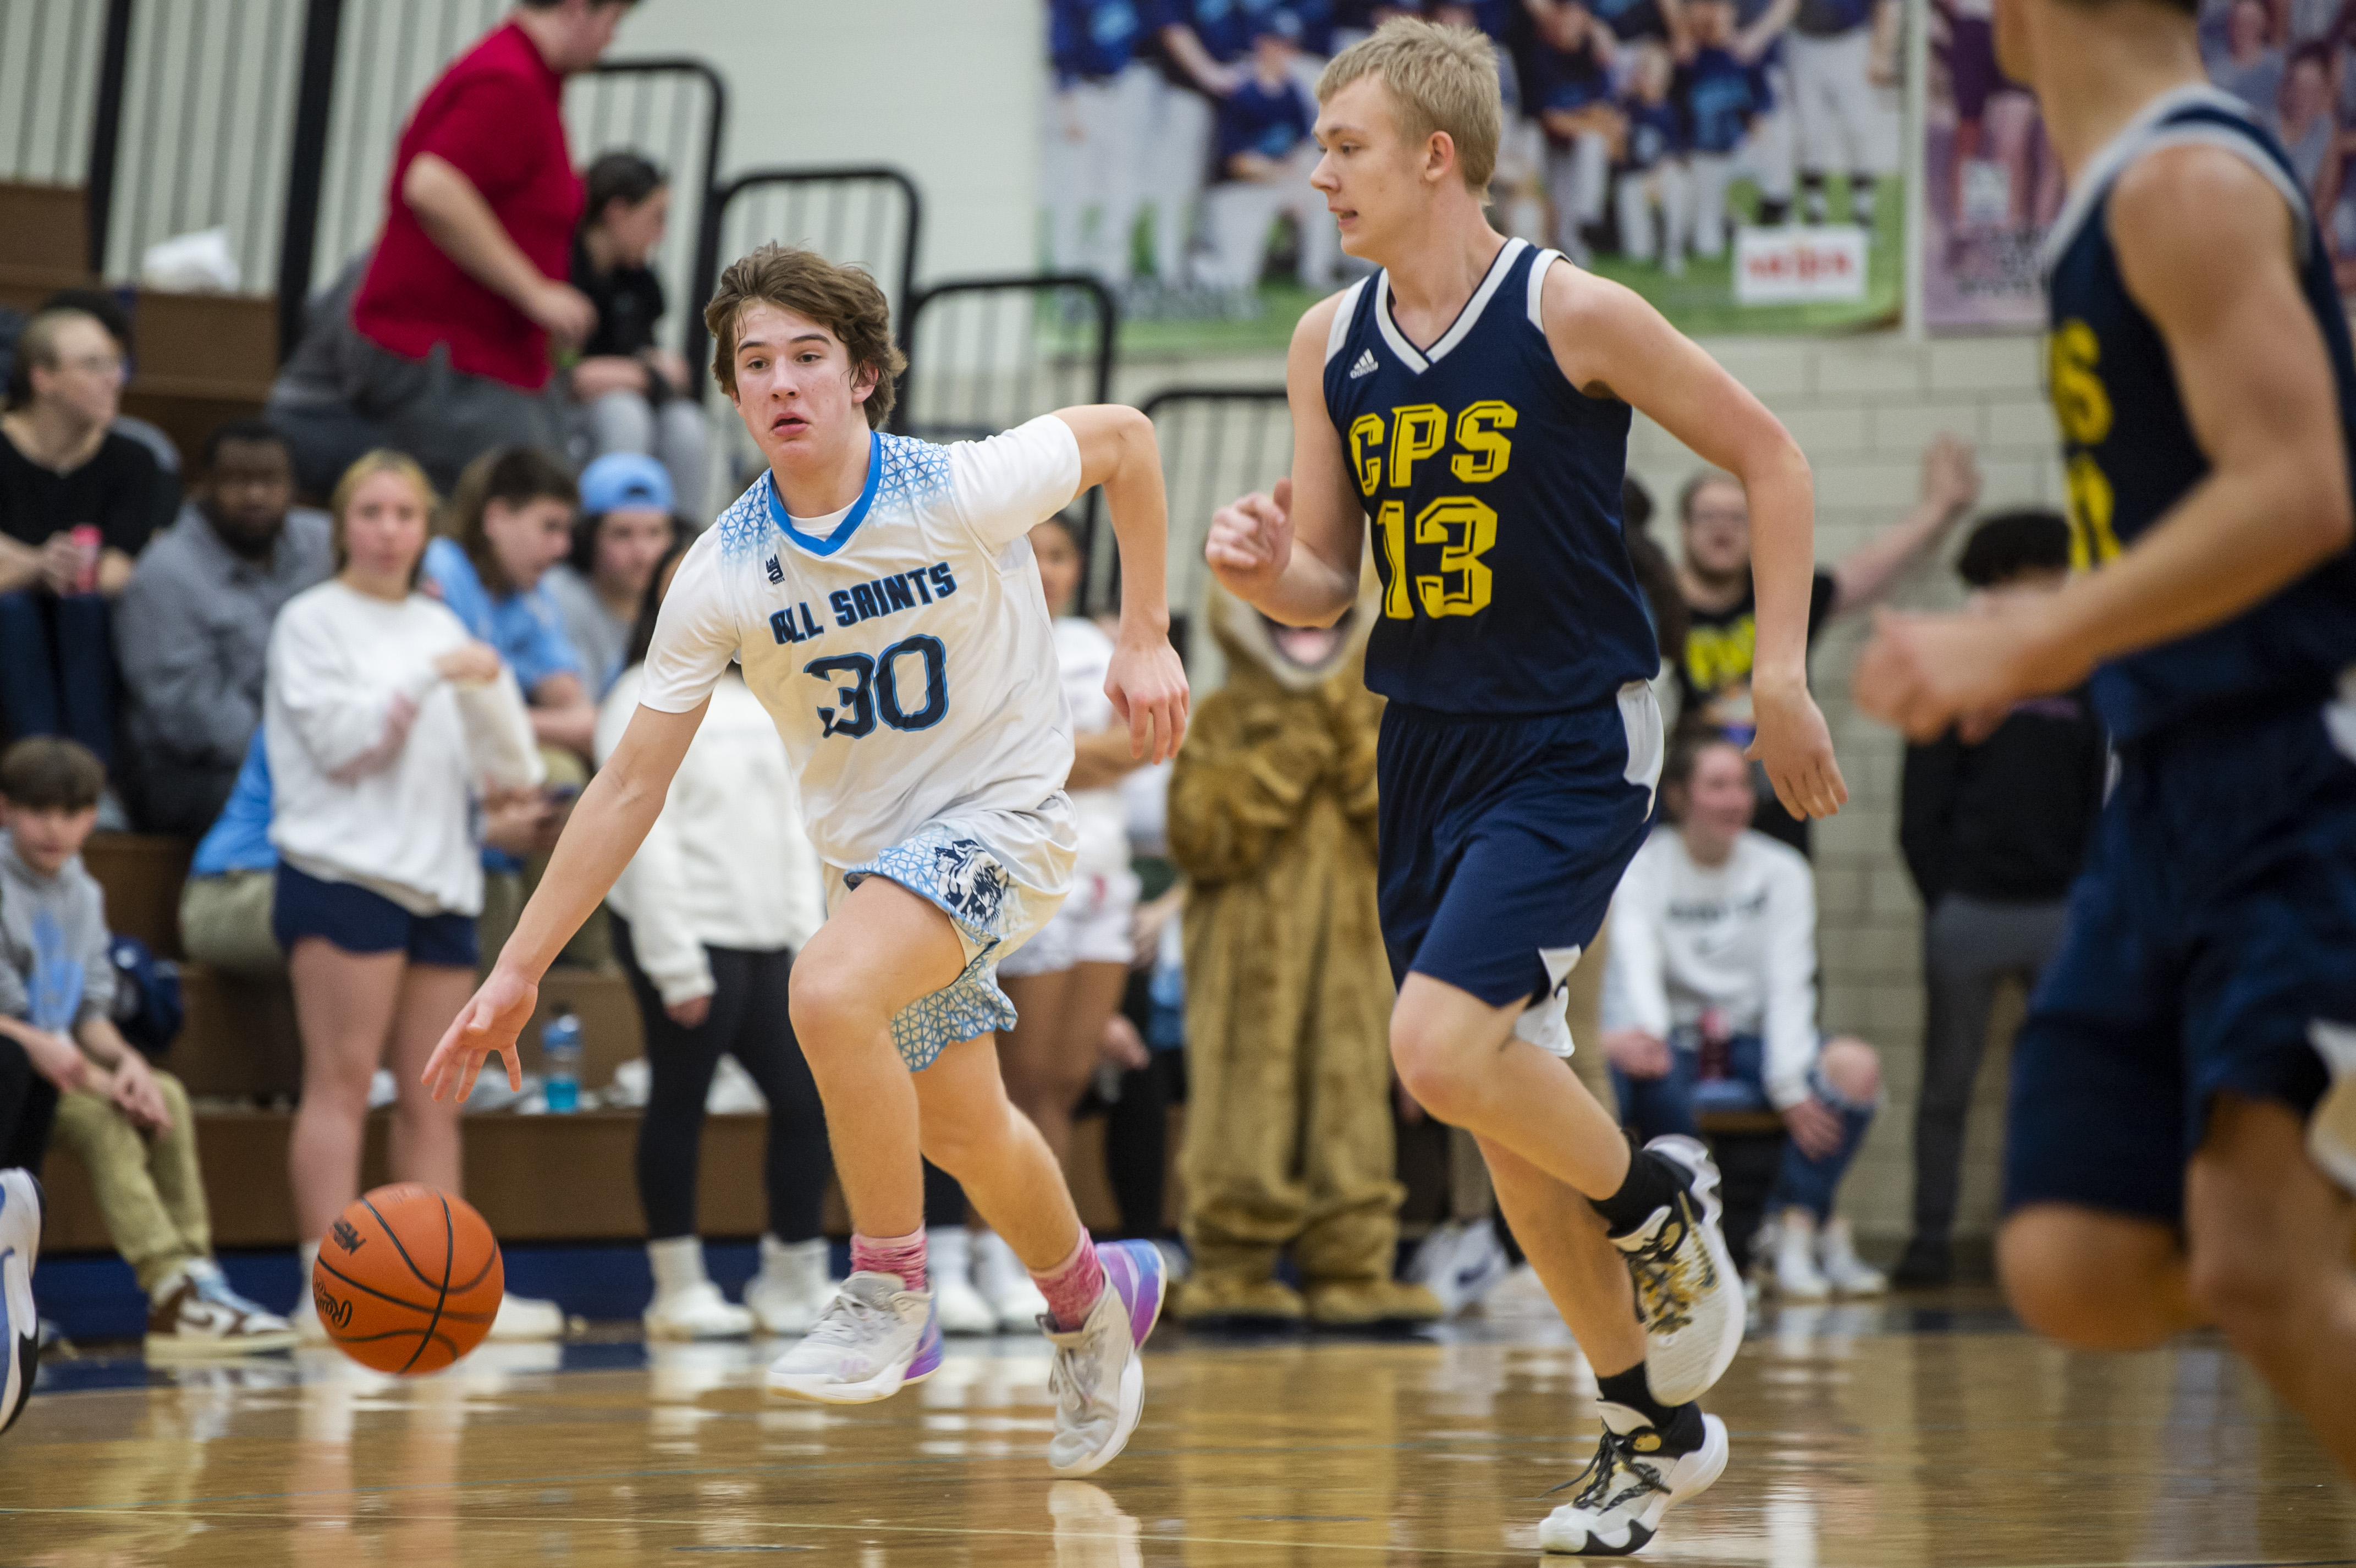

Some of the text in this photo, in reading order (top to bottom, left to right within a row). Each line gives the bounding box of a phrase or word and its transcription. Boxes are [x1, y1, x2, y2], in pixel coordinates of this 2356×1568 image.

[1349, 400, 1518, 497] CPS
[769, 562, 957, 645] ALL SAINTS
[1377, 496, 1498, 619] 13
[803, 634, 949, 740] 30
